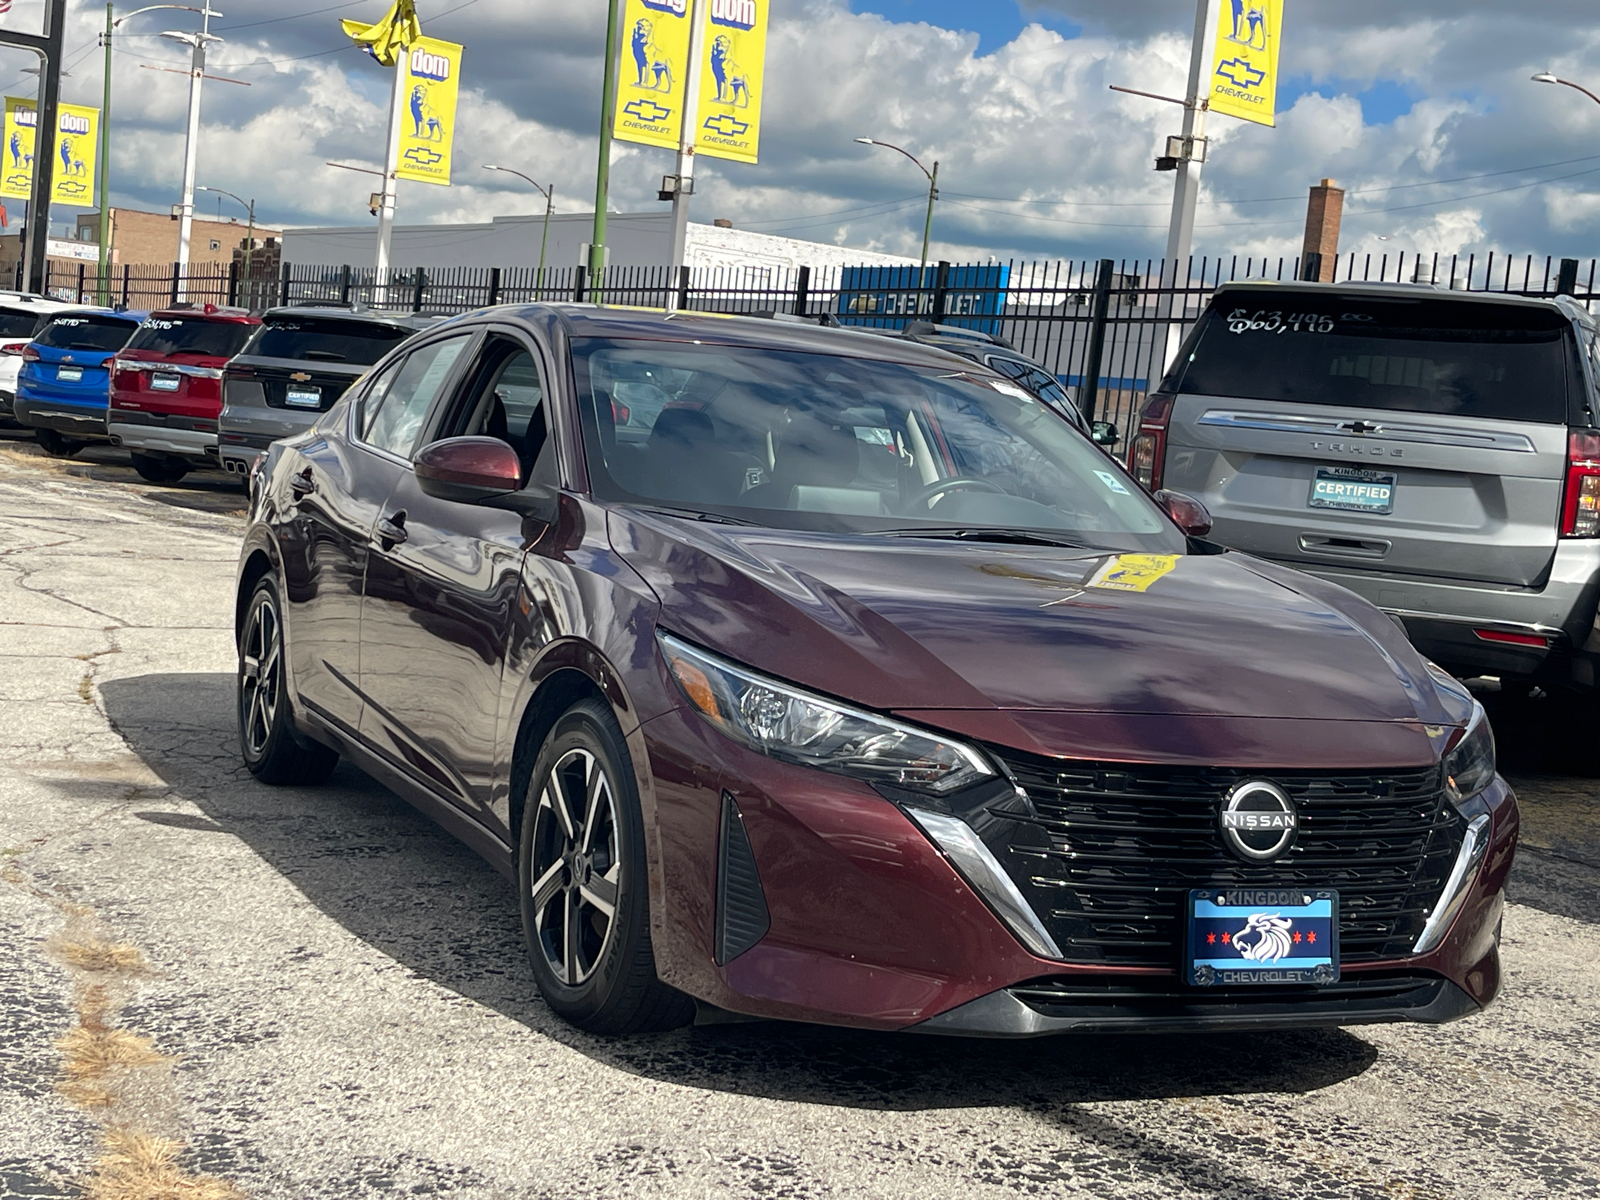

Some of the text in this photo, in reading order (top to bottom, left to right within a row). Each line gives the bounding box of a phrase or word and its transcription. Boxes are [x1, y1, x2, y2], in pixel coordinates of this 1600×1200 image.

[411, 47, 450, 80] dom
[1215, 84, 1265, 104] CHEVROLET
[14, 105, 37, 126] Kin
[60, 112, 89, 134] dom
[623, 120, 671, 134] CHEVROLET
[703, 135, 749, 149] CHEVROLET
[403, 162, 443, 174] CHEVROLET
[1227, 308, 1334, 334] $63,495
[288, 392, 320, 401] CERTIFIED
[1310, 441, 1403, 457] TAHOE
[1334, 467, 1377, 477] KINGDOM
[1316, 482, 1390, 499] CERTIFIED
[1224, 814, 1295, 827] NISSAN
[1226, 891, 1300, 905] KINGDOM
[1223, 970, 1304, 982] CHEVROLET
